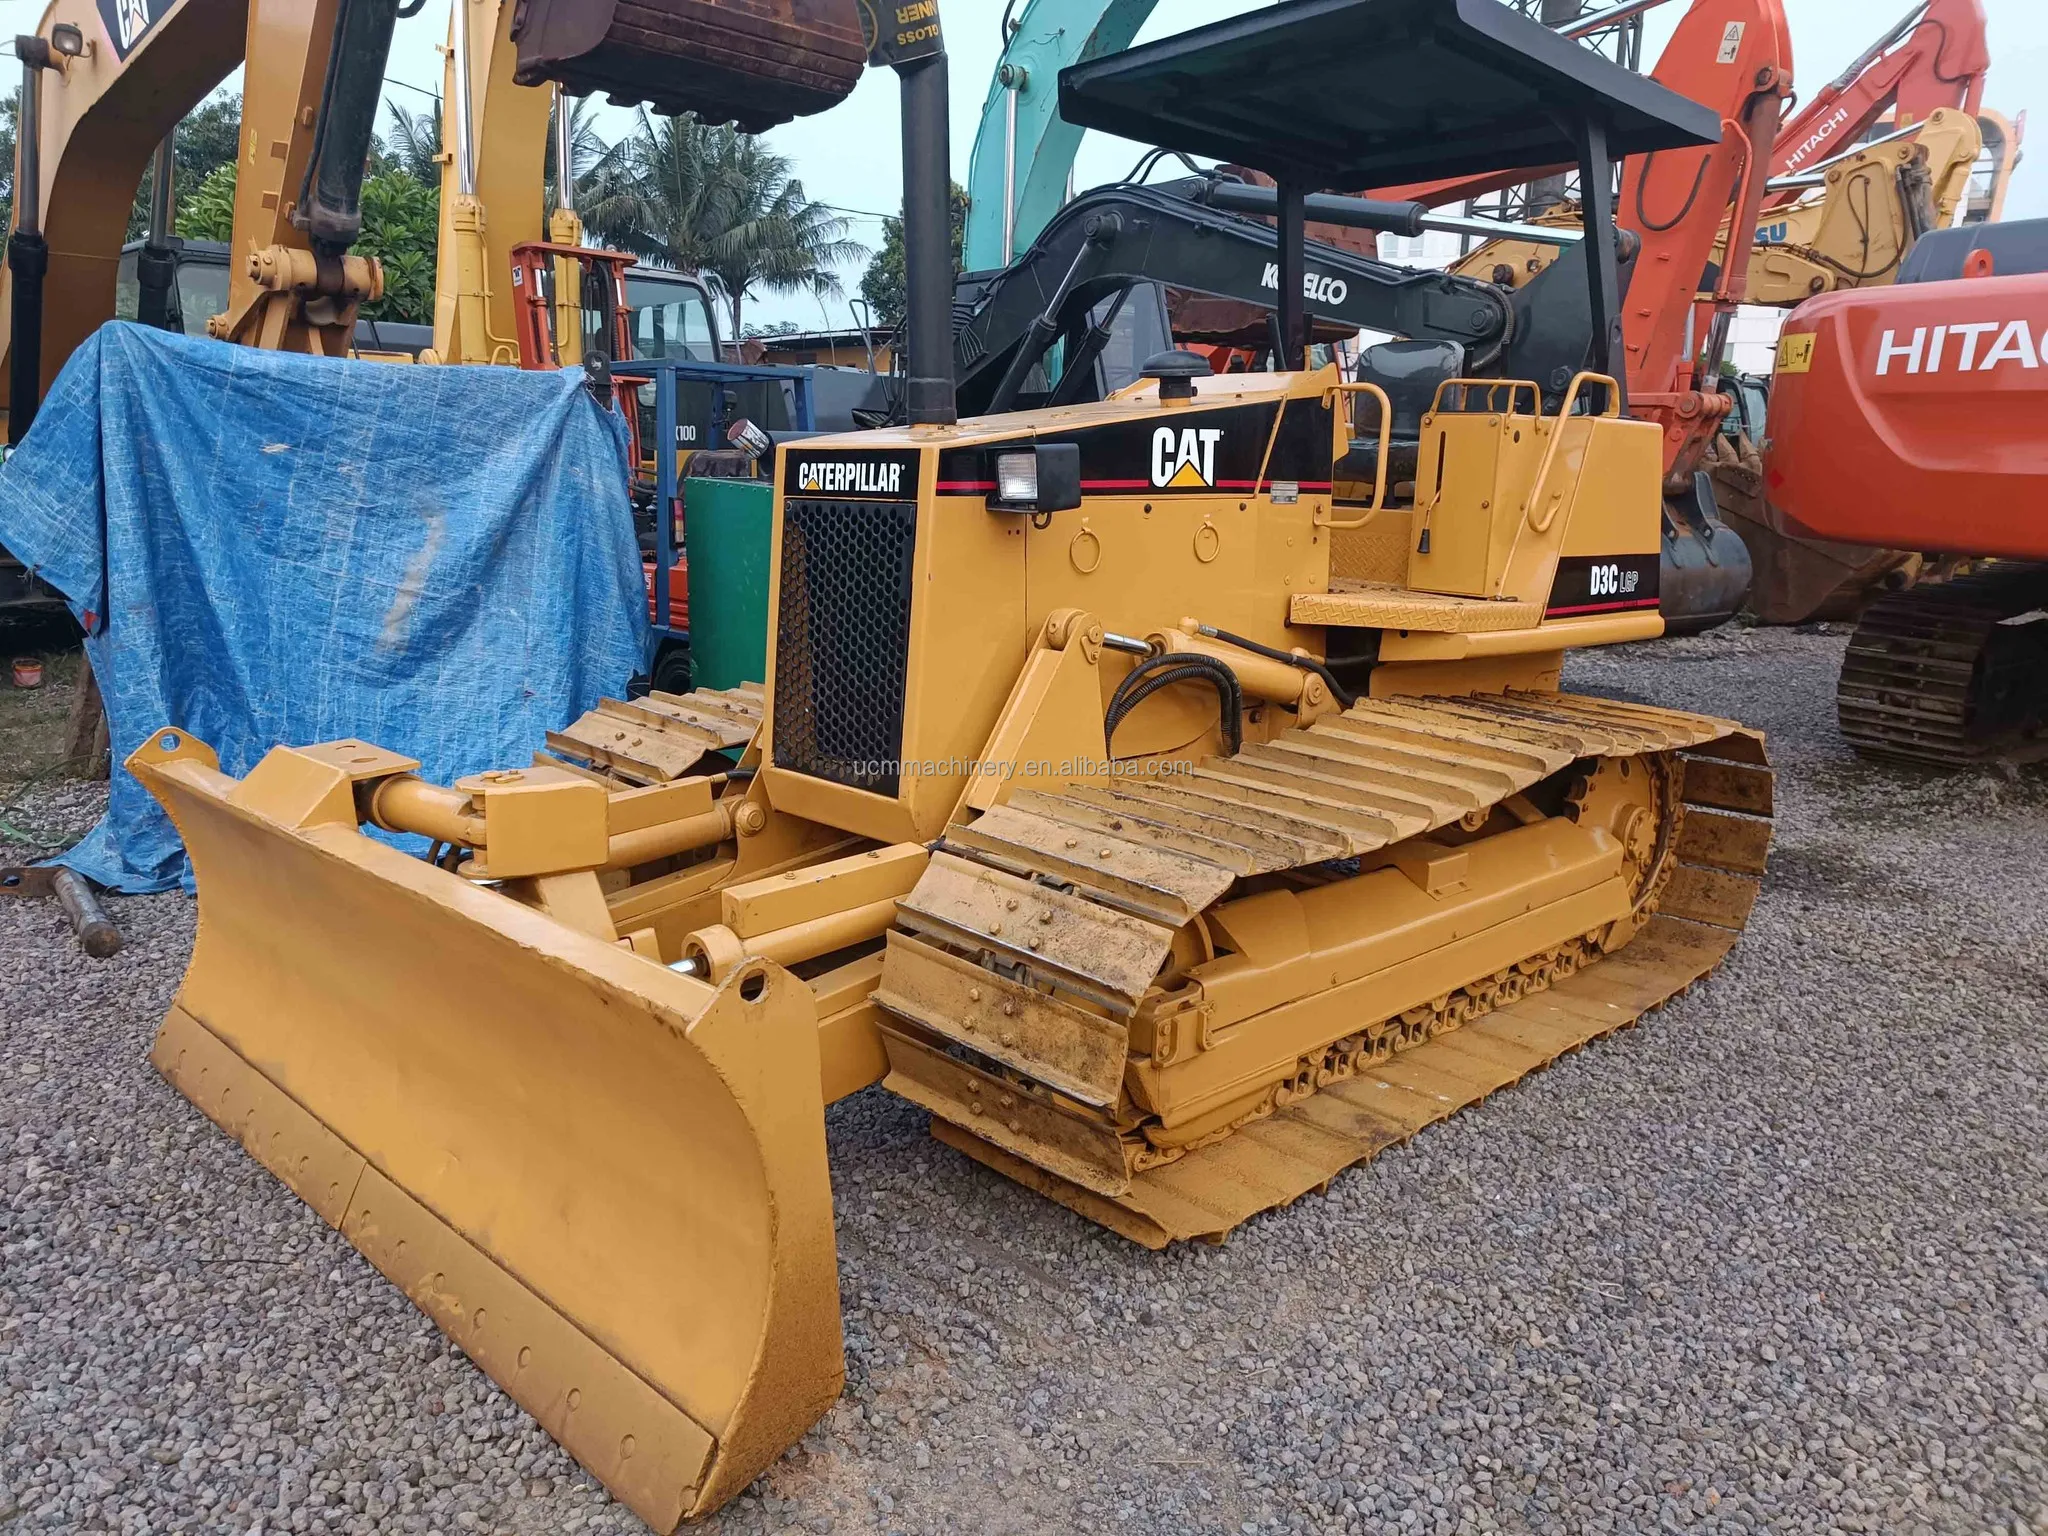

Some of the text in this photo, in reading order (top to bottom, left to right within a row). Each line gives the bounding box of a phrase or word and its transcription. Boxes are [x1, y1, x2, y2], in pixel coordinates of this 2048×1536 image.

[897, 24, 939, 45] GLOSS
[1785, 107, 1849, 170] HITACHI
[1261, 262, 1347, 305] KELCO
[1876, 320, 2048, 376] HITA
[798, 462, 901, 492] CATERPILLAR
[1151, 426, 1221, 488] CAT
[1590, 564, 1639, 596] D3C LGP
